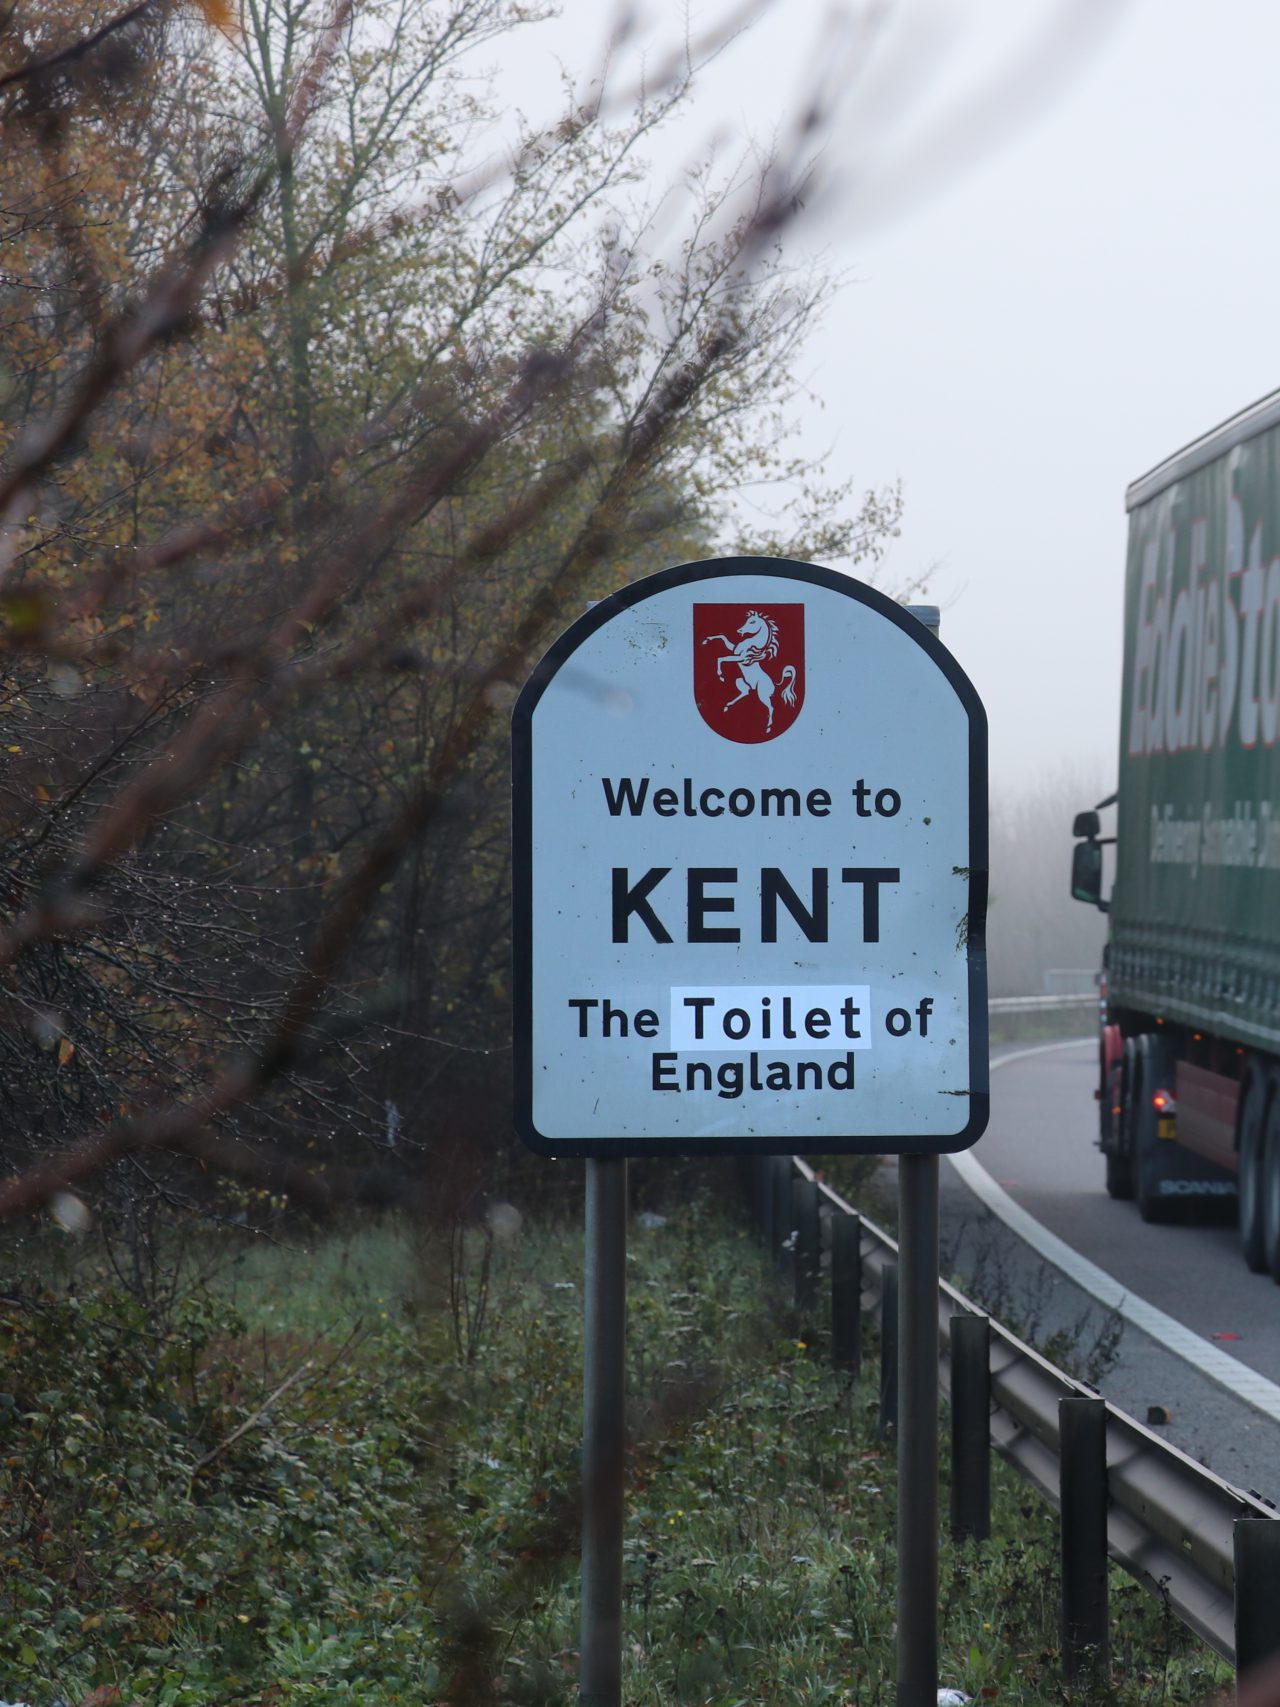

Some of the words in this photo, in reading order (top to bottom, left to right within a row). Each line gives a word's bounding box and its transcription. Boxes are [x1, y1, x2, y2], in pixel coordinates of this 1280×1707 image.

[602, 778, 832, 818] Welcome
[852, 779, 902, 818] to
[612, 868, 901, 944] KENT
[569, 999, 660, 1038] The
[683, 997, 861, 1040] Toilet
[885, 998, 934, 1037] of
[652, 1052, 855, 1099] England
